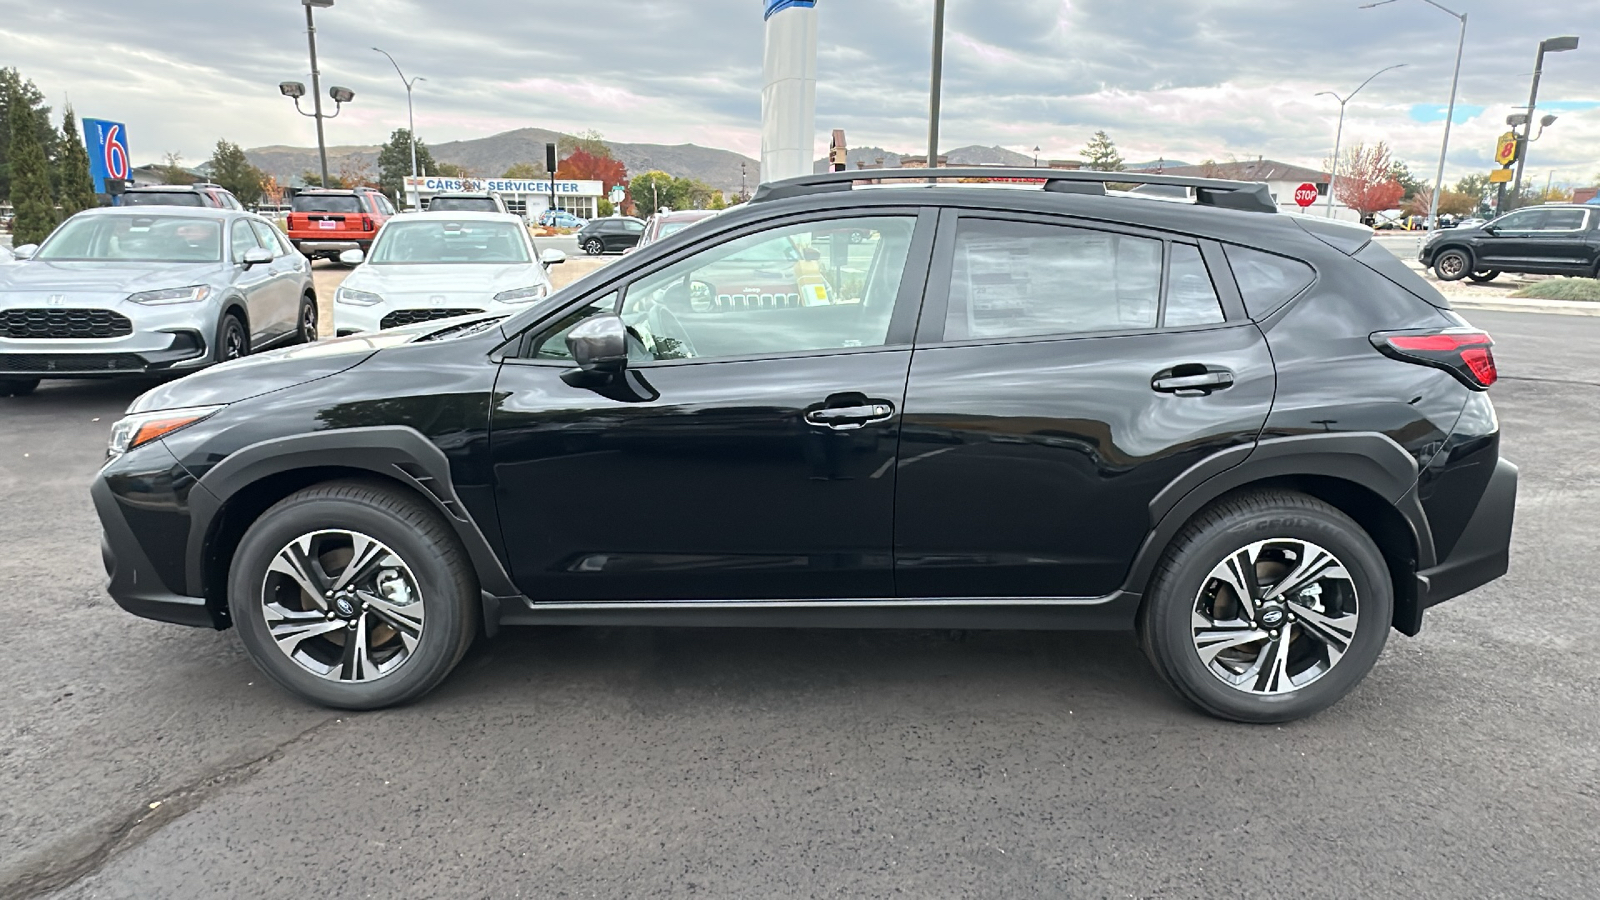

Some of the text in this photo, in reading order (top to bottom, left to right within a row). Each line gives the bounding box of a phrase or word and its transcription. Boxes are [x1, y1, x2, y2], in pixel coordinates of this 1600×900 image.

[105, 125, 128, 179] 6
[1501, 143, 1513, 158] 8
[488, 181, 579, 192] SERVICENTER
[1296, 190, 1316, 200] STOP
